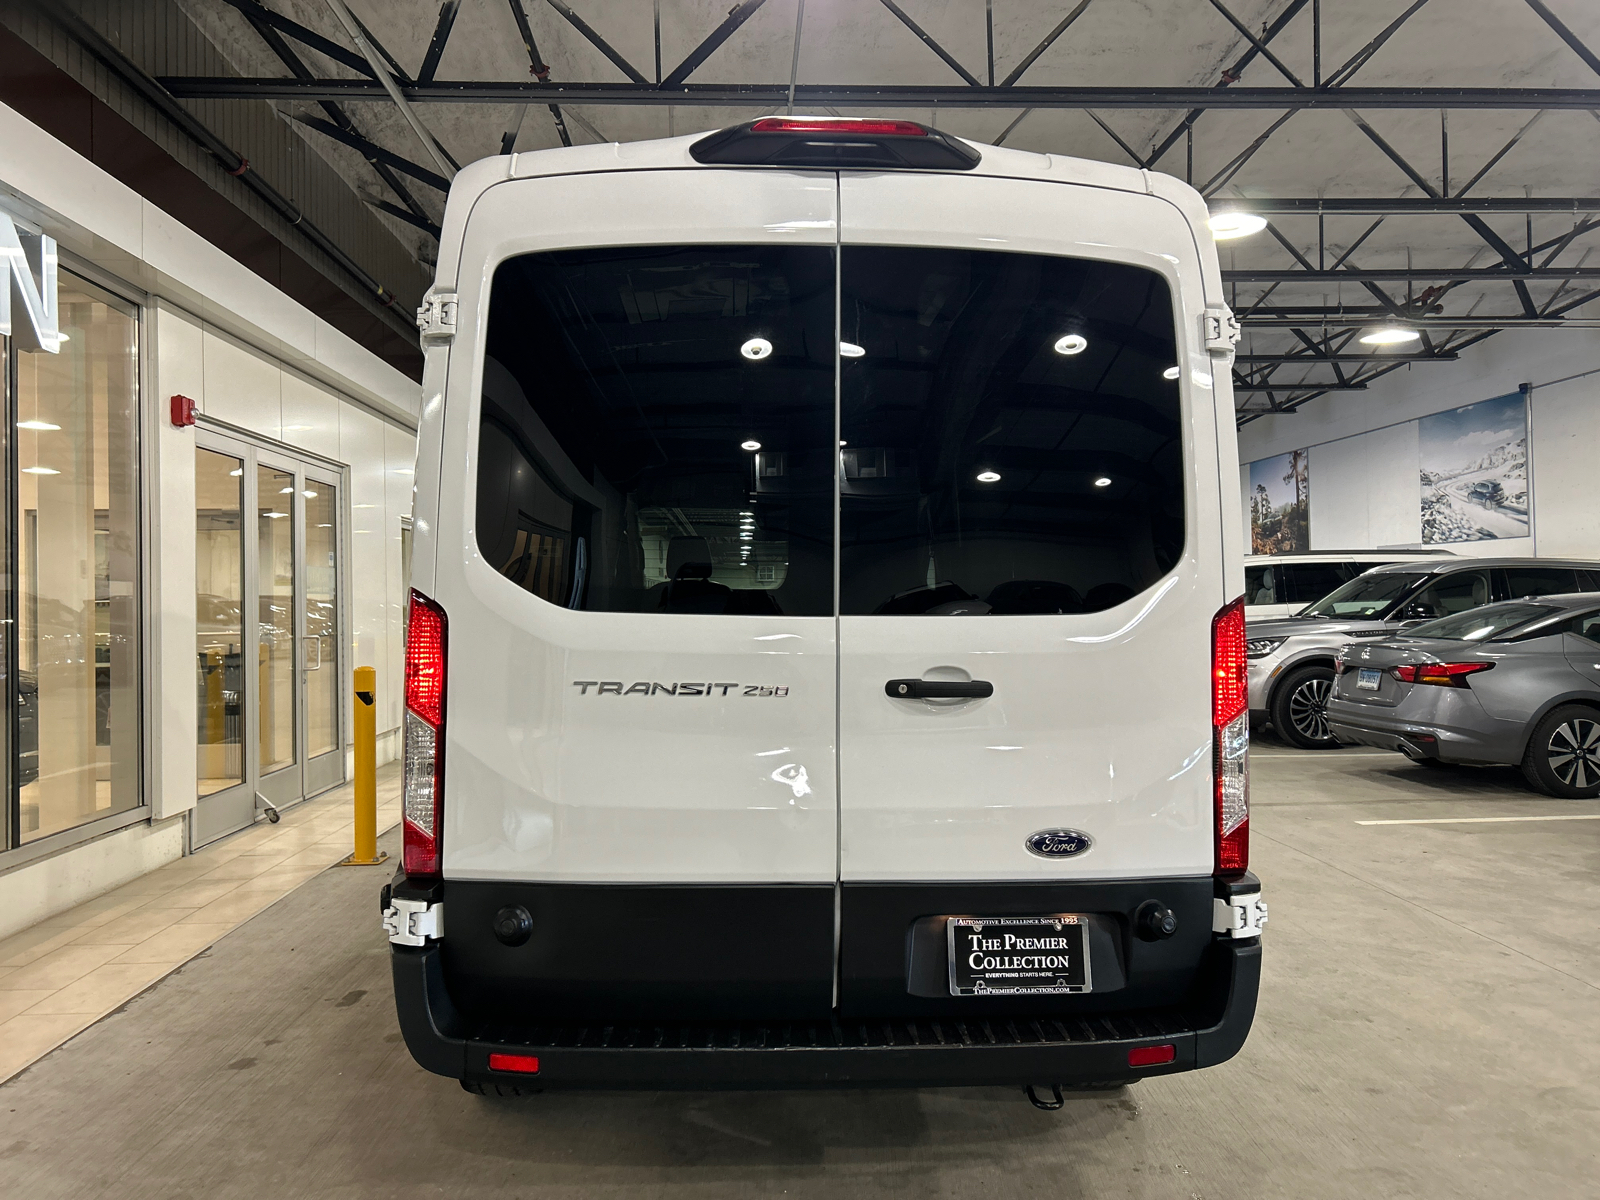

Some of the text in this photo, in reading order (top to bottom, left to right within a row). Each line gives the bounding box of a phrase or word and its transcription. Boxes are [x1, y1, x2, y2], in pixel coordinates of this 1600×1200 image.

[573, 681, 789, 697] TRANSIT 250
[1042, 836, 1078, 852] Ford
[968, 934, 1068, 951] THE PREMIER
[968, 952, 1069, 970] COLLECTION
[973, 986, 1070, 995] THEPREMIERCOLLECTION.COM
